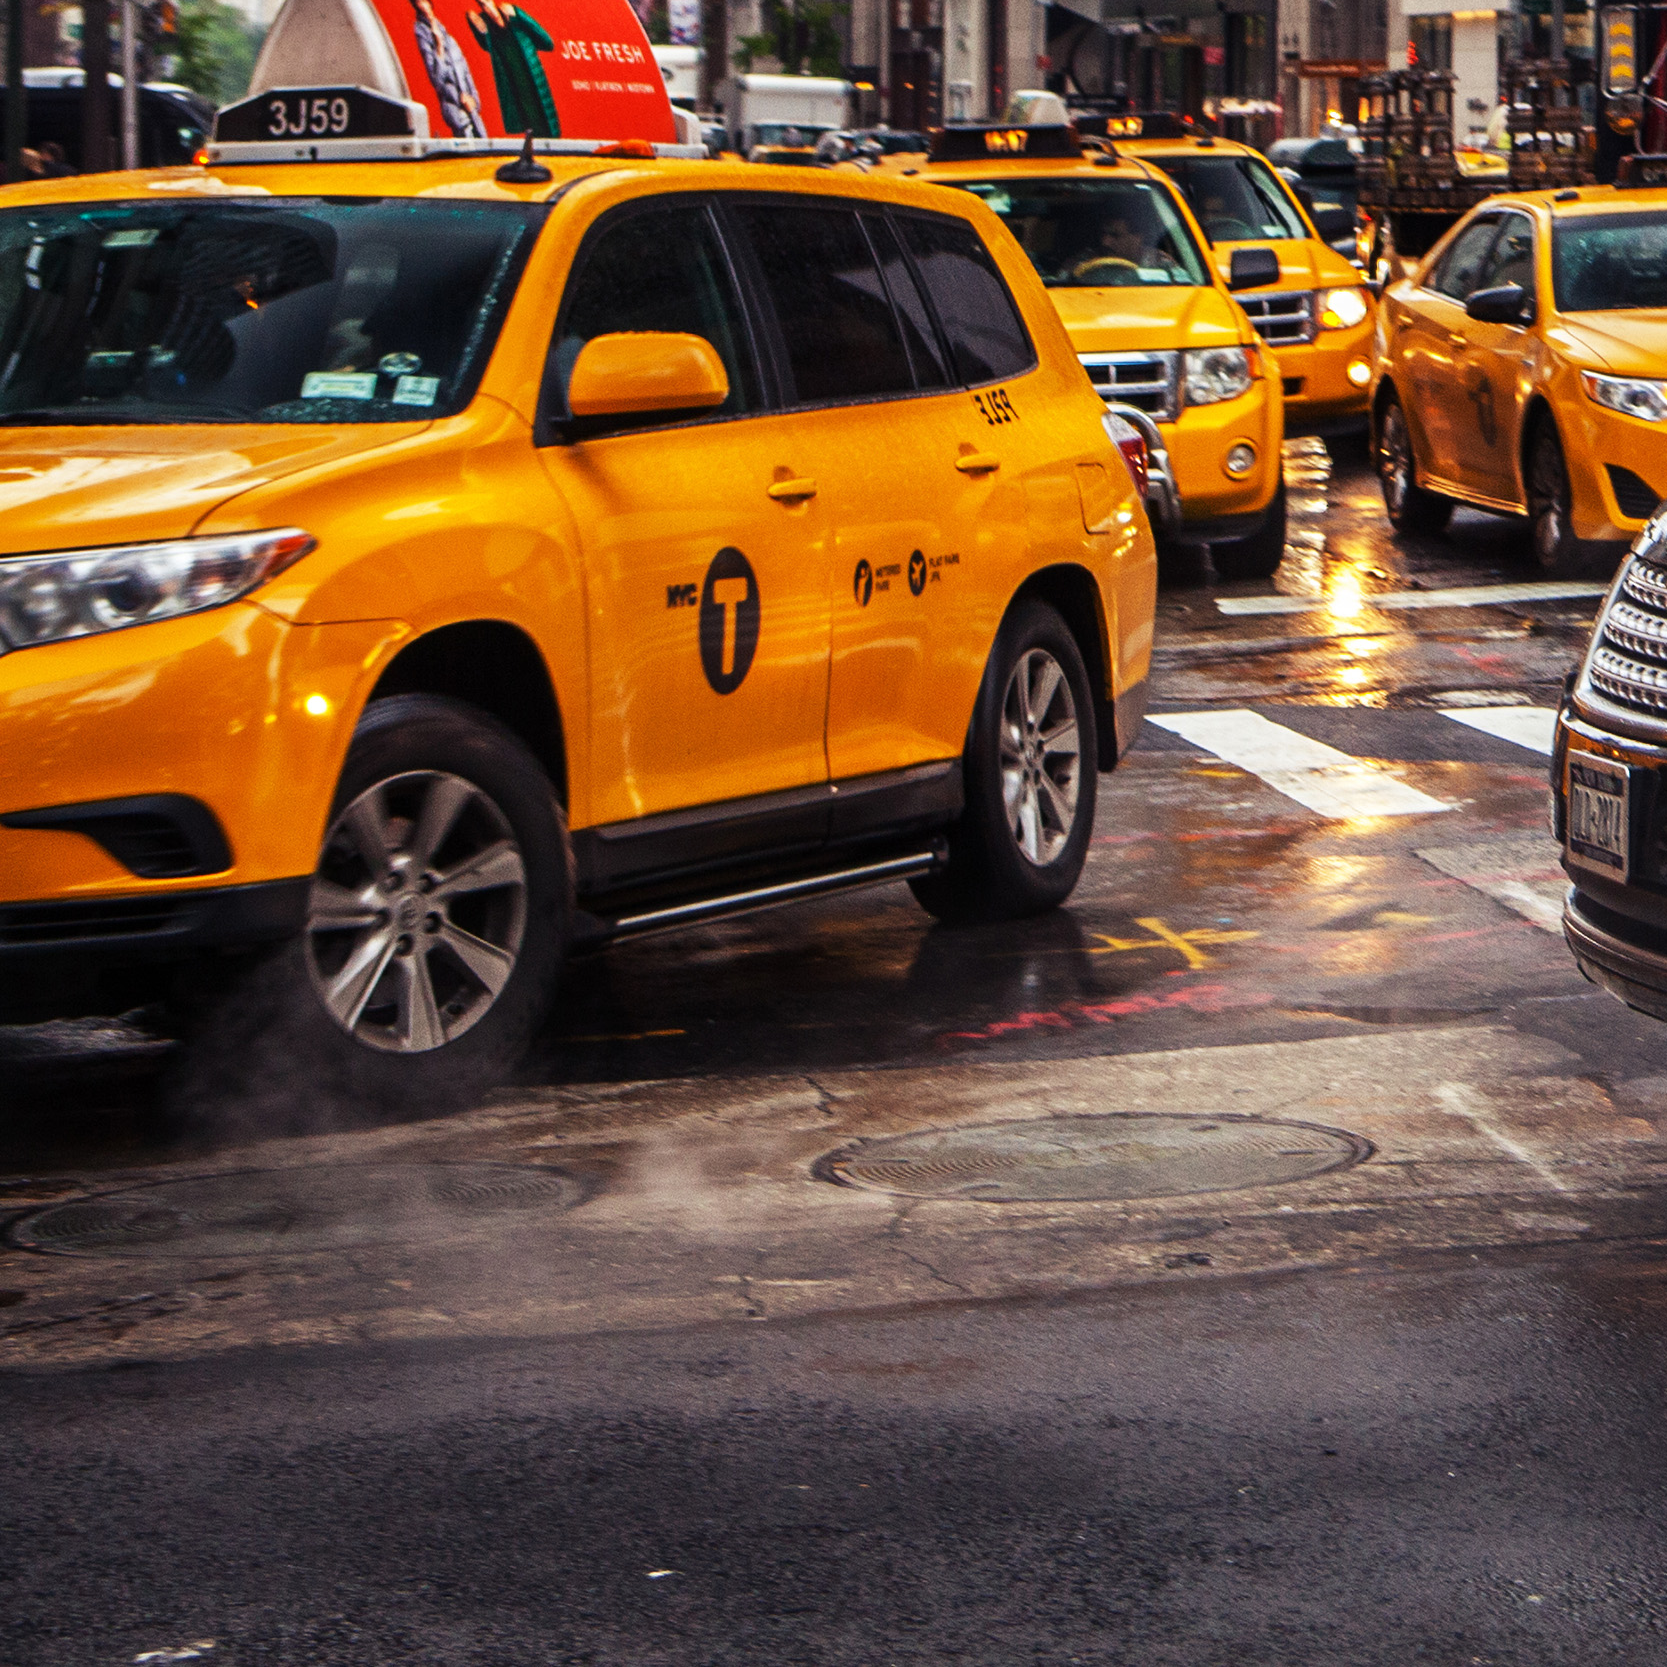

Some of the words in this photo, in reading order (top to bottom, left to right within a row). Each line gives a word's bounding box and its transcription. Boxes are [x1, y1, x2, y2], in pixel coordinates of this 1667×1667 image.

[560, 39, 592, 61] JOE
[592, 41, 646, 64] FRESH
[268, 98, 349, 136] 3J59
[974, 389, 1019, 426] 3J59
[666, 583, 698, 610] NYC
[712, 577, 749, 676] T
